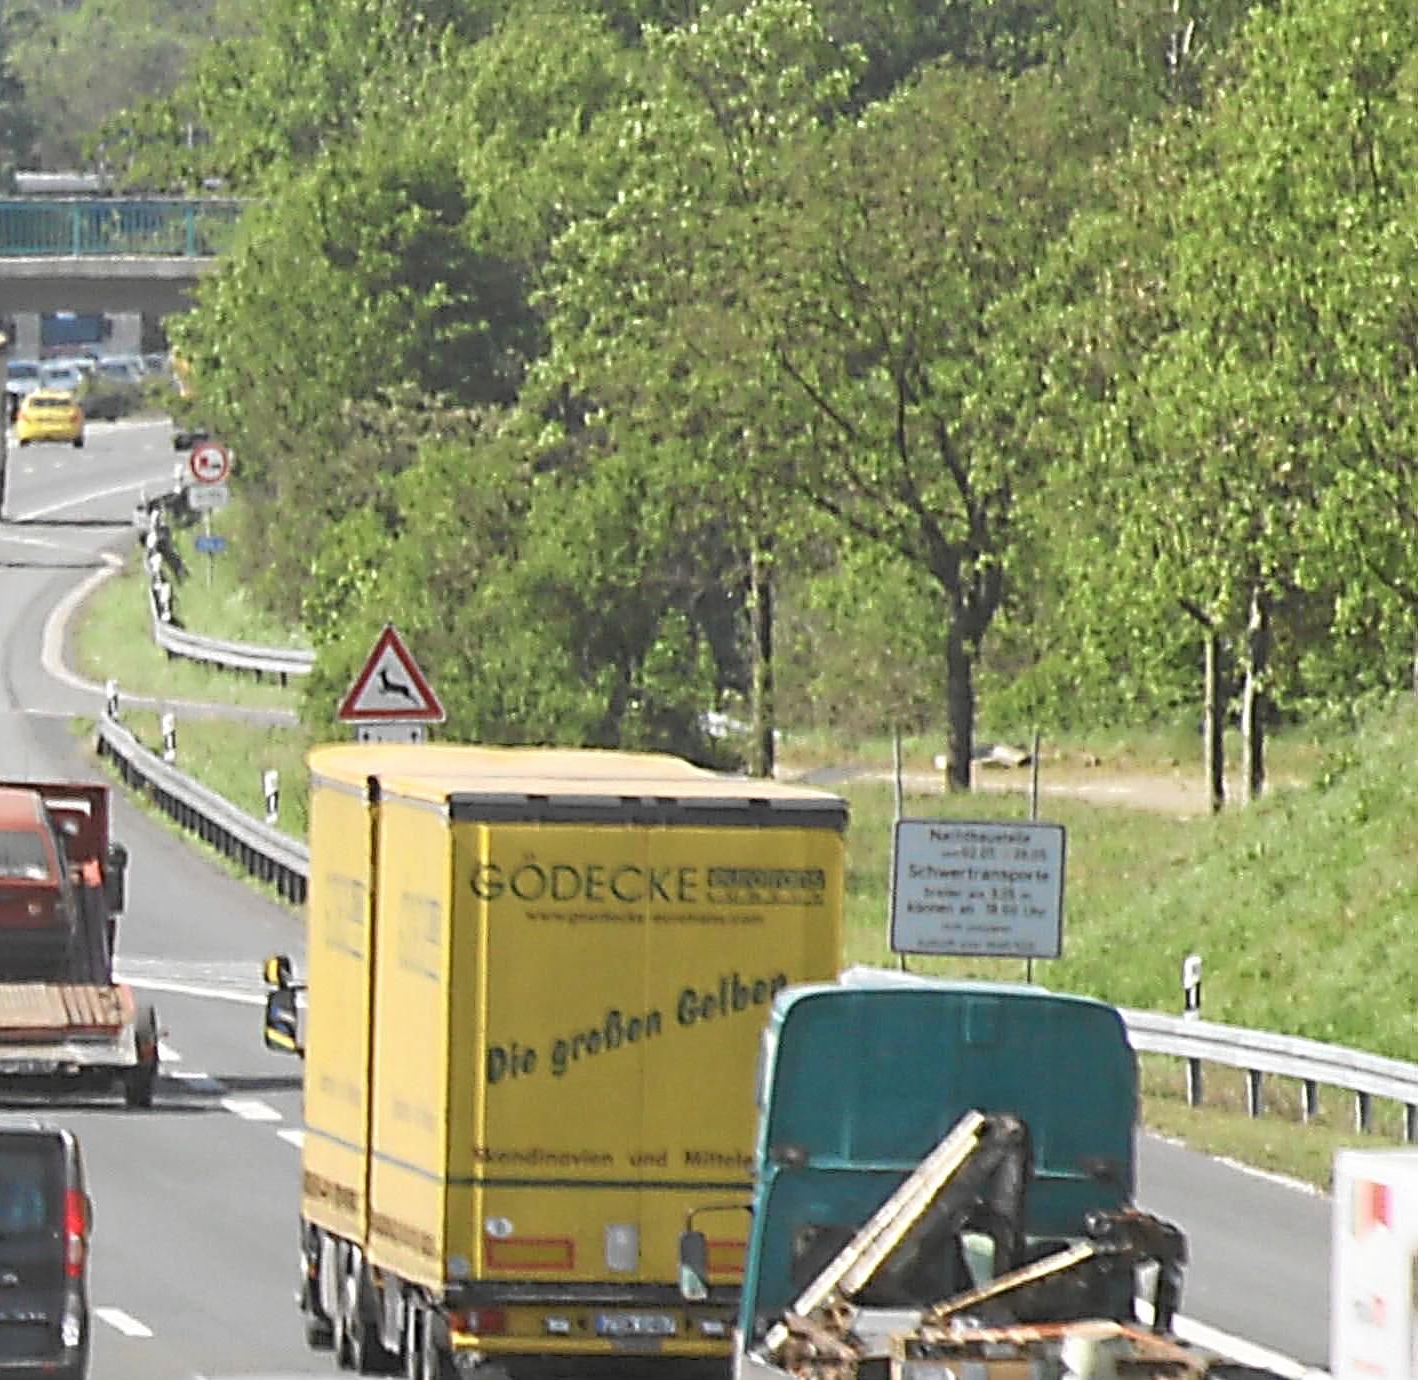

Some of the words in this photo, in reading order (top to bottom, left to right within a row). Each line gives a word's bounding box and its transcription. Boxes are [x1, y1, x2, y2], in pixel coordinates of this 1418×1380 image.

[470, 853, 698, 902] GÖDECKE
[909, 864, 1049, 881] Schwertransporte
[487, 1042, 538, 1083] Die
[552, 1008, 662, 1076] großen
[630, 1150, 668, 1168] und
